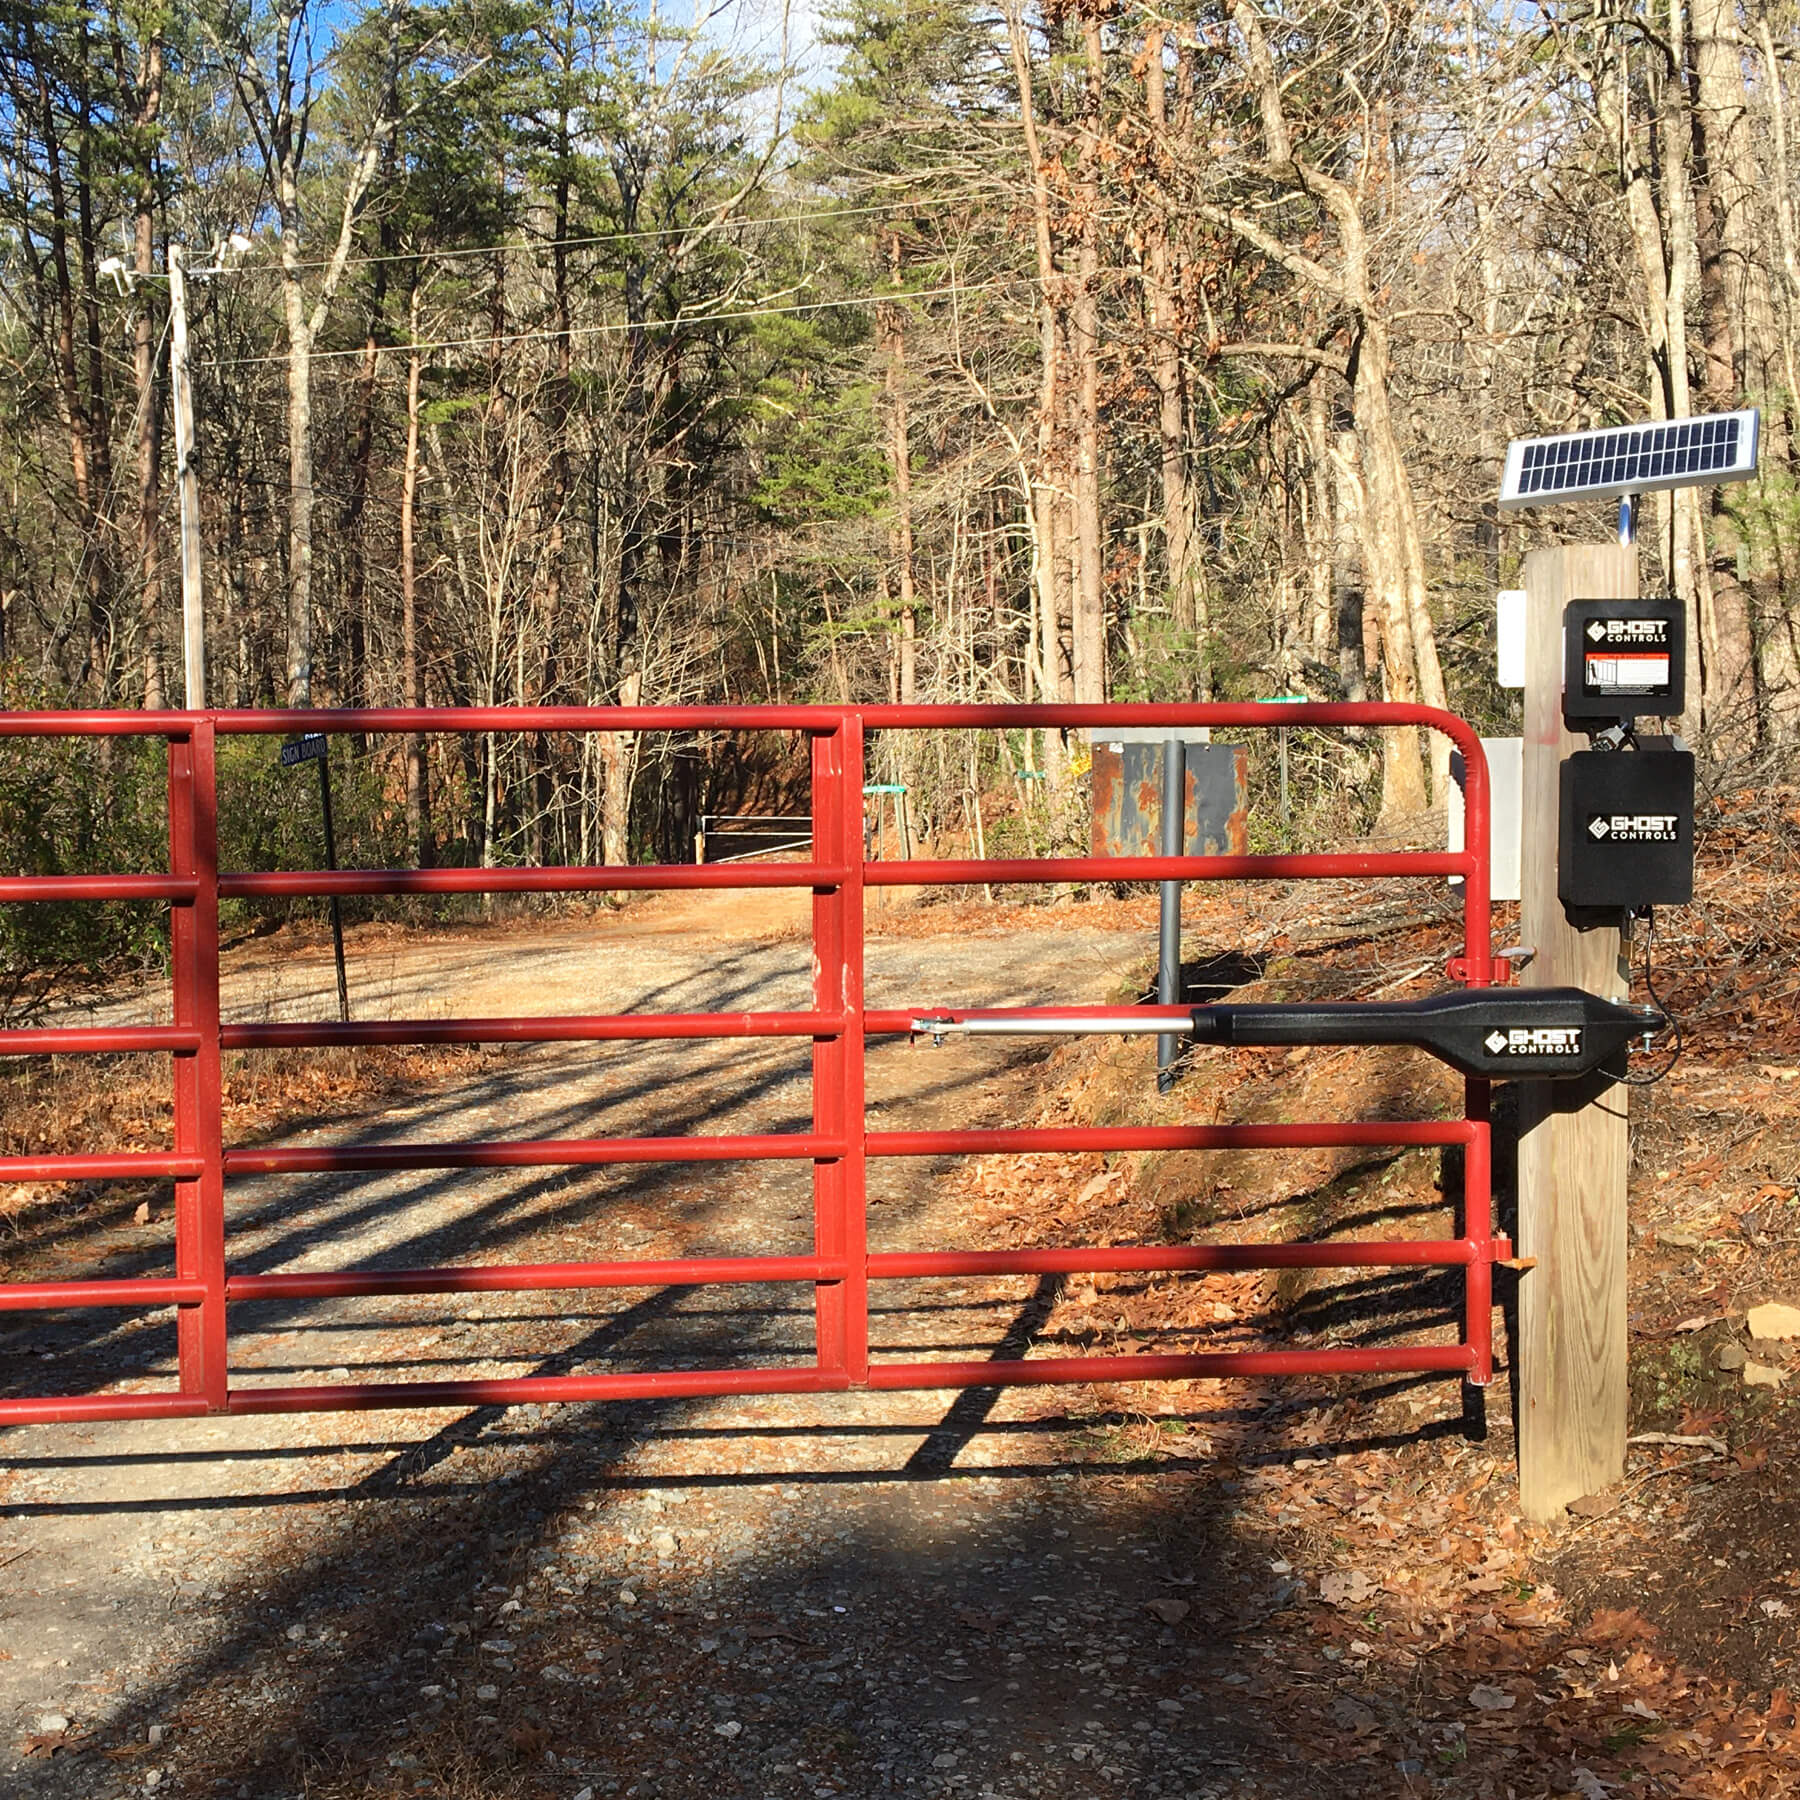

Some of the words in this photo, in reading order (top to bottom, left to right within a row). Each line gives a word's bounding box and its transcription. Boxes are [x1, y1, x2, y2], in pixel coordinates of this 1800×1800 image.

[1607, 620, 1668, 634] GHOST
[1607, 634, 1667, 642] CONTROLS
[282, 745, 300, 765] SIGN
[1611, 816, 1678, 831] GHOST
[1611, 831, 1676, 840] CONTROLS
[1508, 1029, 1581, 1044] GHOST
[1508, 1045, 1580, 1054] CONTROLS
